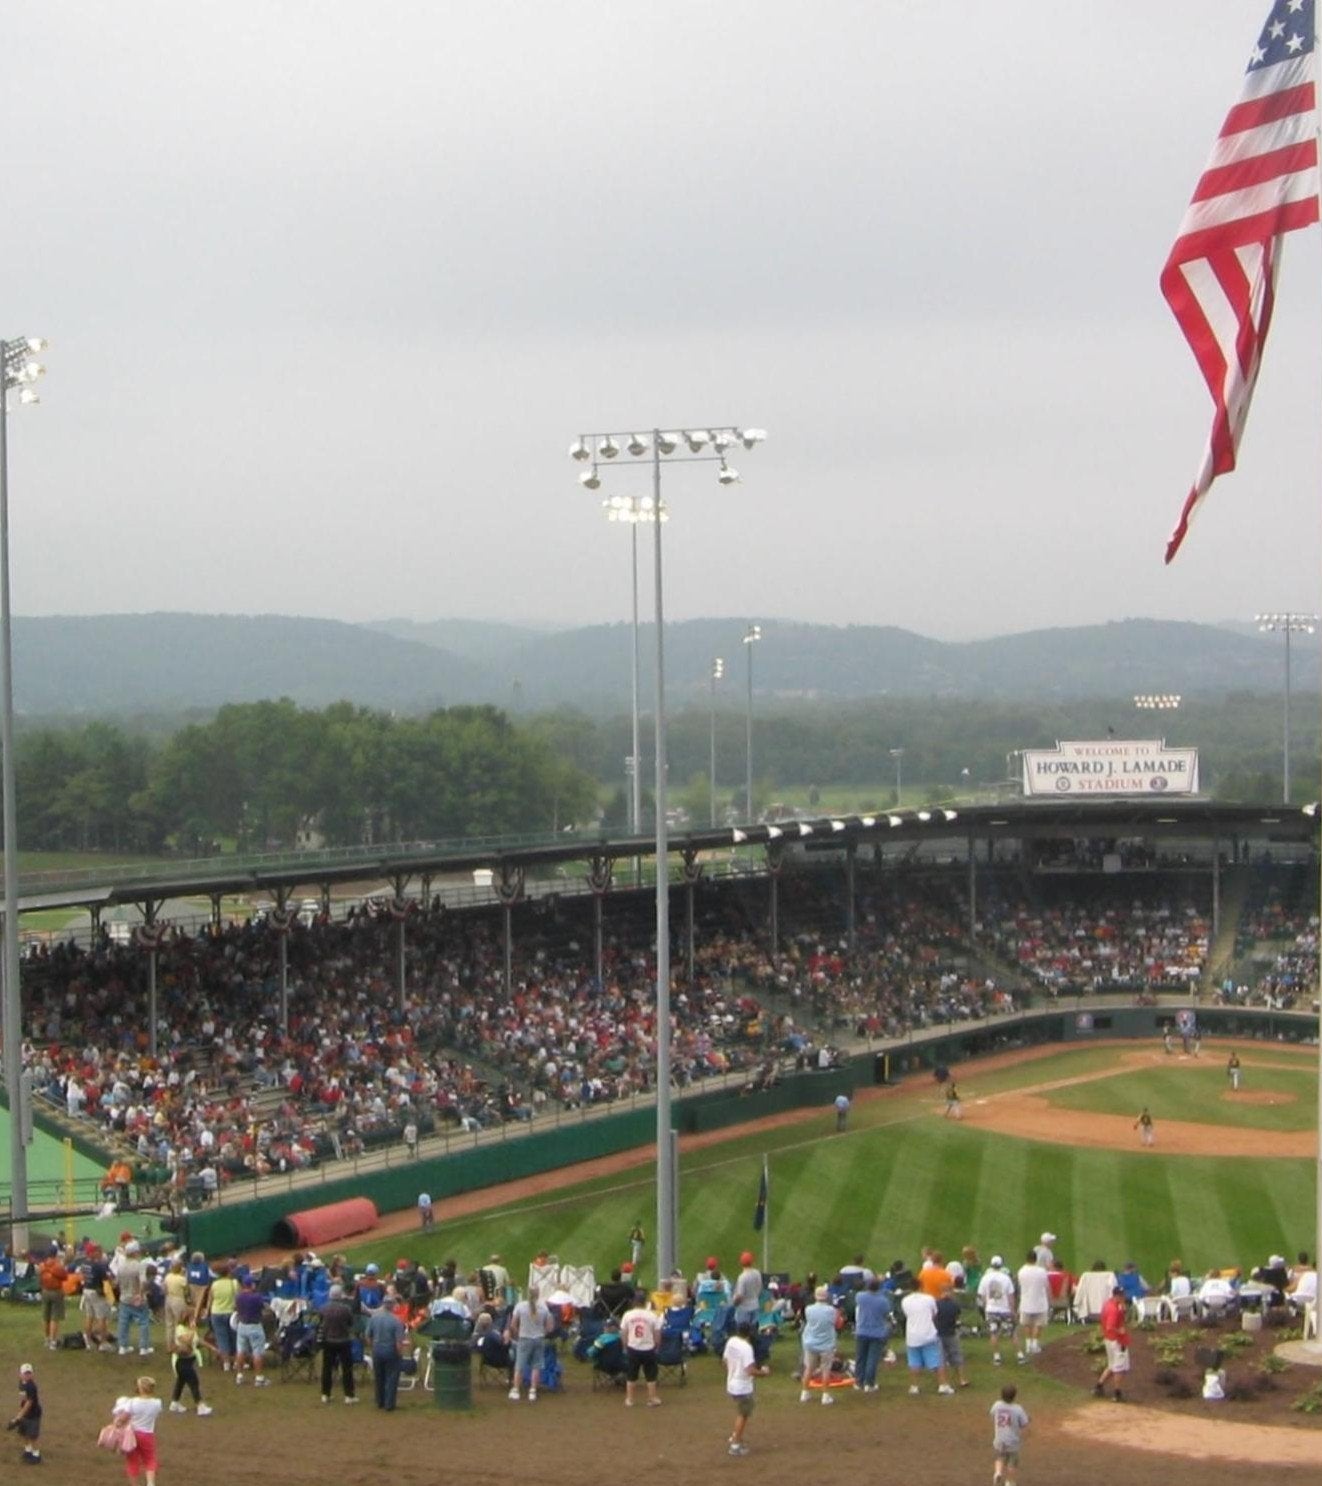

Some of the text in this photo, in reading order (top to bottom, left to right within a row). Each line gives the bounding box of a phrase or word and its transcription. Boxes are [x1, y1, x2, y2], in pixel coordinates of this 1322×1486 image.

[1074, 747, 1149, 756] WELCOME TO
[1036, 760, 1187, 777] HOWARD J. LAMADE
[1078, 778, 1143, 790] STADIUM
